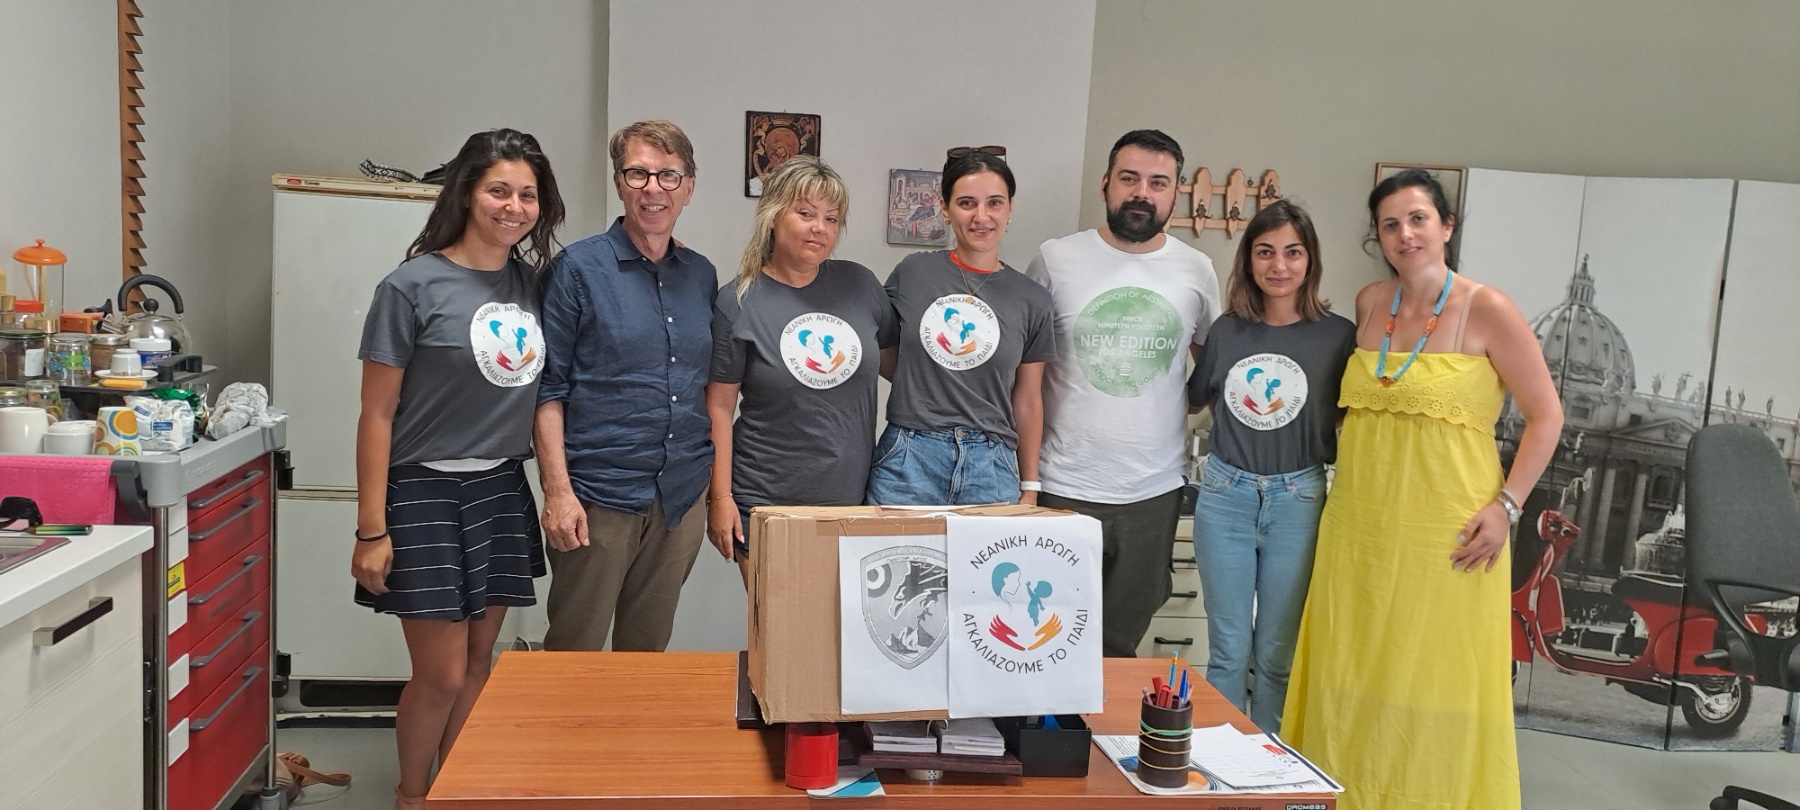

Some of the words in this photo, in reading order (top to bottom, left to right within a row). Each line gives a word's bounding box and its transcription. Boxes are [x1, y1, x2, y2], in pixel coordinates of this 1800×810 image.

[1088, 291, 1127, 316] DEFINITION
[1129, 290, 1140, 298] OF
[785, 316, 812, 335] ΝΕΑΝΙΚΗ
[816, 315, 843, 326] ΑΡΩΓΗ
[1098, 322, 1130, 330] NINETEEN
[924, 327, 960, 368] ΑΓΚΑΛΙΑΖΟΥΜΕ
[977, 342, 992, 360] ΠΑΙΔΙ
[1080, 335, 1114, 347] NEW
[1119, 336, 1178, 350] EDITION
[1117, 350, 1157, 358] ANGELES
[481, 351, 524, 384] ΑΓΚΑΛΙΑΖΟΥΜΕ
[527, 369, 536, 379] ΤΟ
[789, 358, 838, 387] ΑΓΚΑΛΙΑΖΟΥΜΕ
[840, 369, 850, 378] ΤΟ
[850, 345, 858, 366] ΠΑΙΔΙ
[1237, 357, 1272, 369] ΝΕΑΝΙΚΗ
[1276, 358, 1300, 374] ΑΡΩΓΗ
[1229, 391, 1273, 428] ΑΓΚΑΛΙΑΖΟΥΜΕ
[1276, 416, 1286, 425] ΤΟ
[1286, 397, 1301, 417] ΠΑΙΔΙ
[970, 535, 1028, 570] ΝΕΑΝΙΚΗ
[1035, 536, 1080, 567] ΑΡΩΓΗ
[963, 612, 1044, 675] ΑΓΚΑΛΙΑΖΟΥΜΕ
[1048, 647, 1067, 666] ΤΟ
[1067, 609, 1089, 646] ΠΑΙΔΙ
